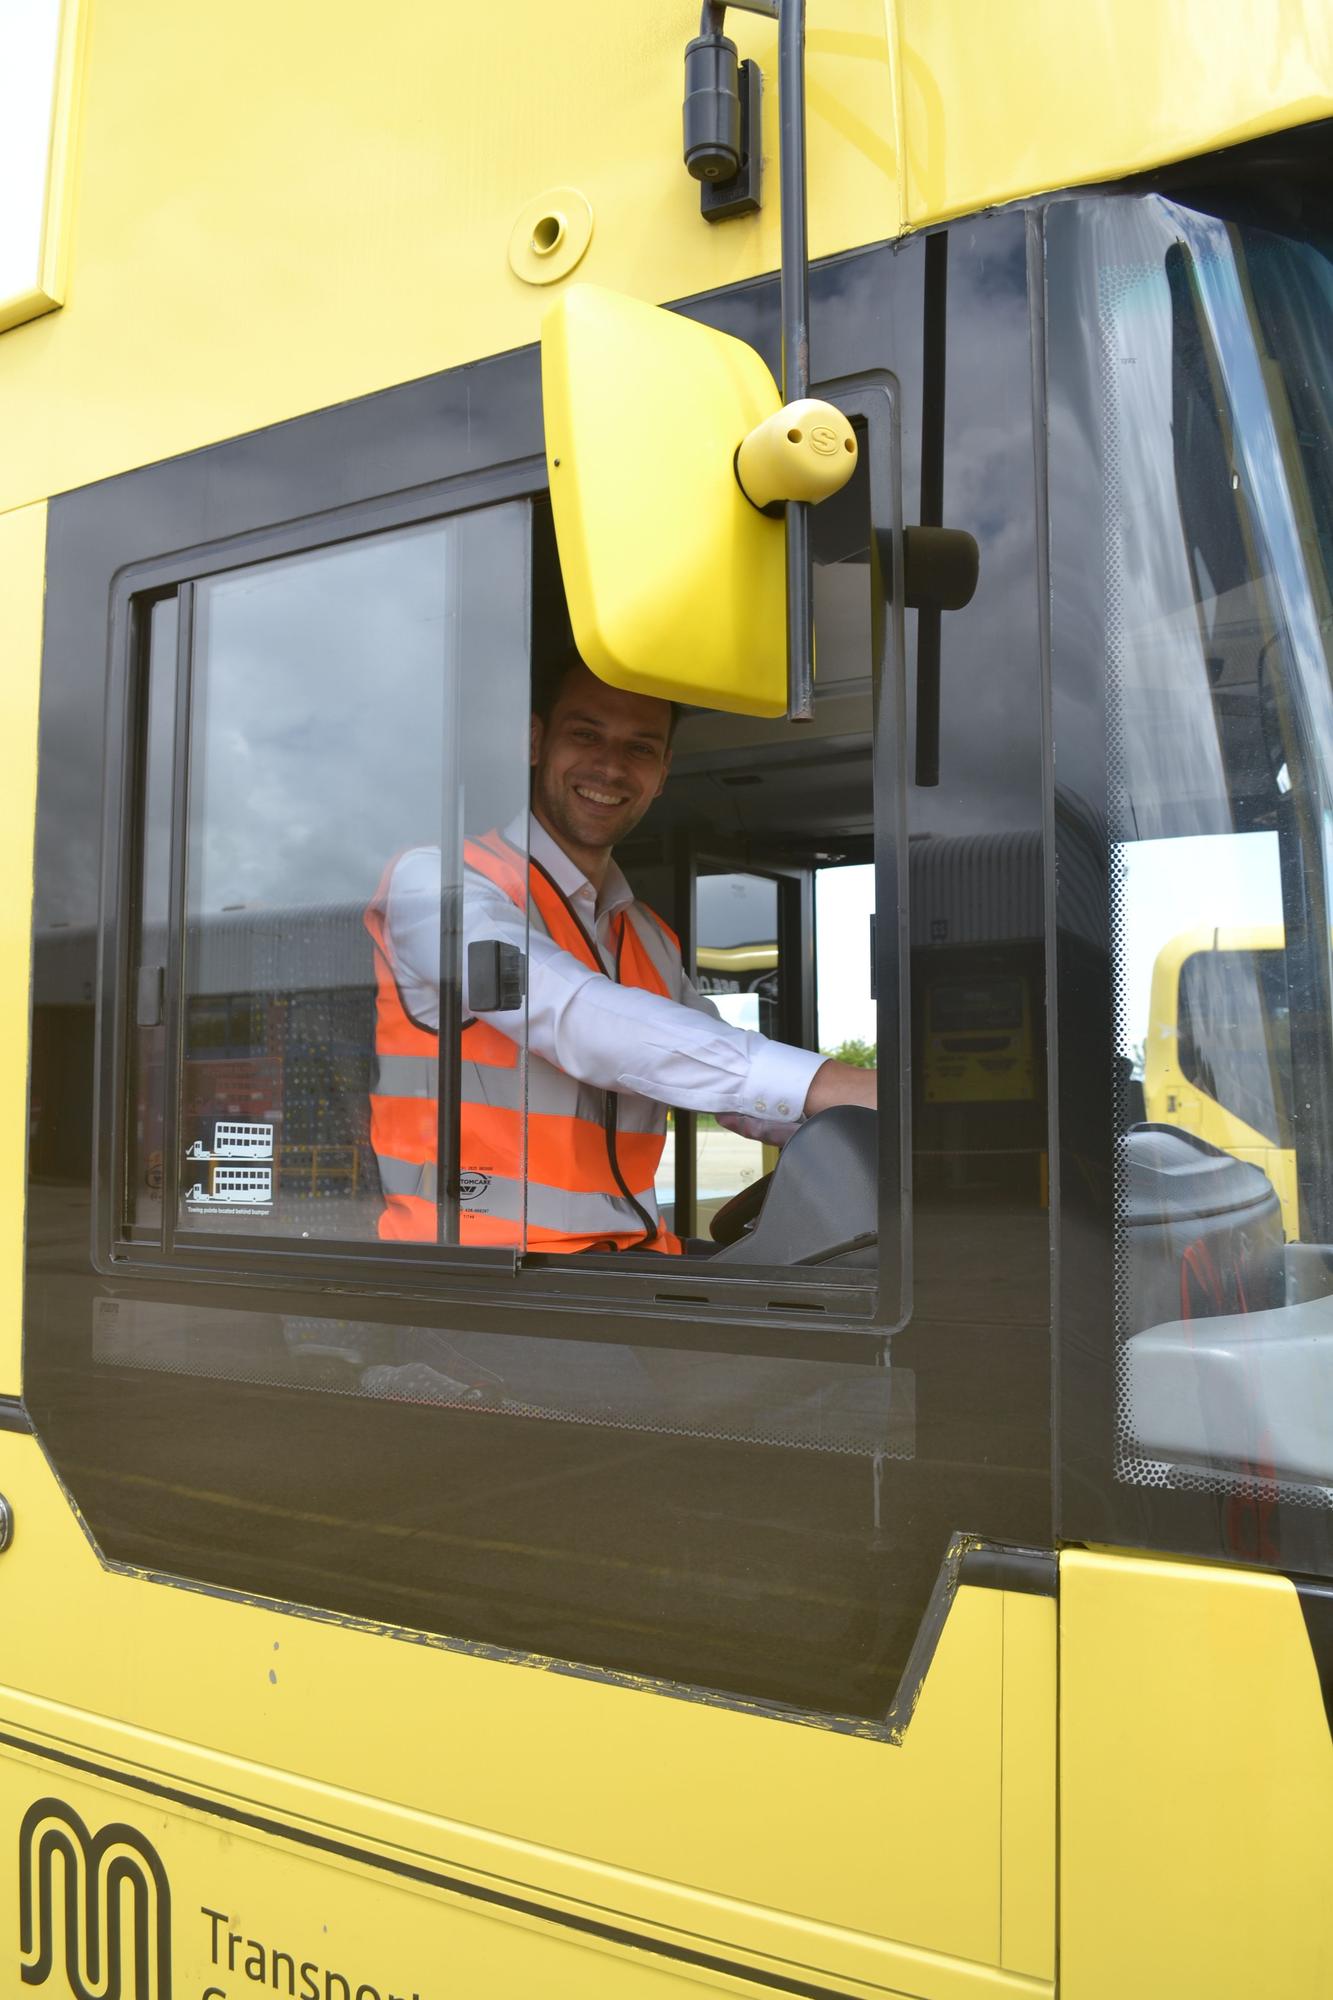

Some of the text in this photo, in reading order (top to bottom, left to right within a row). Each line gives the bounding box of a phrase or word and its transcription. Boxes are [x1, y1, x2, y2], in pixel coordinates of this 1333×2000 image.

[187, 1206, 203, 1215] Towing
[204, 1207, 217, 1215] points
[252, 1208, 270, 1216] bumper
